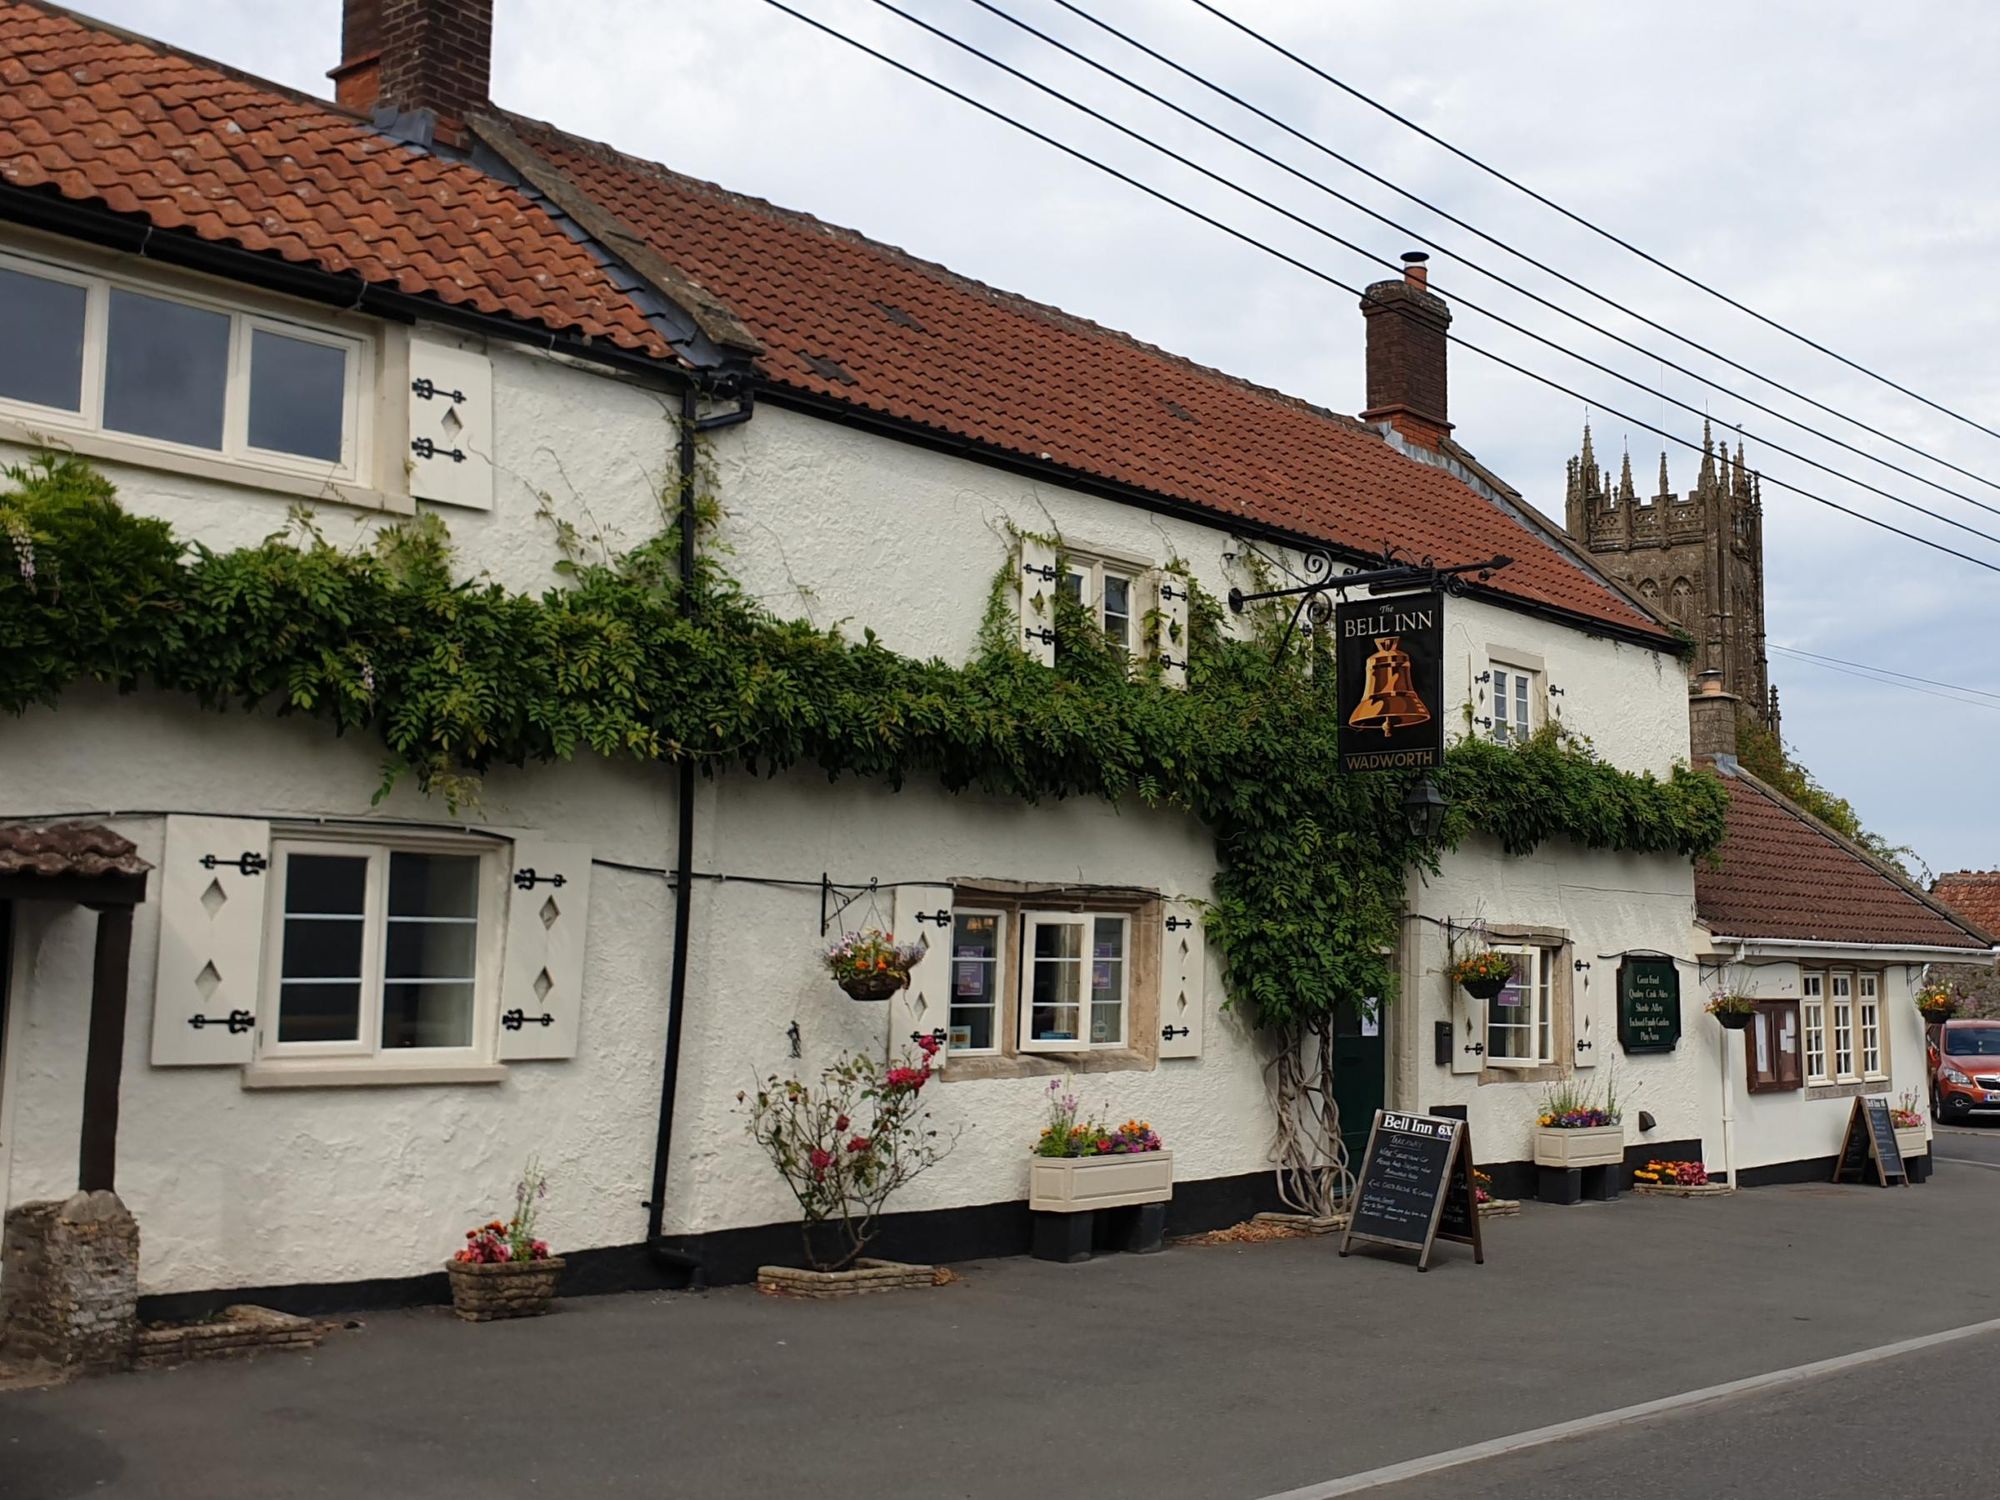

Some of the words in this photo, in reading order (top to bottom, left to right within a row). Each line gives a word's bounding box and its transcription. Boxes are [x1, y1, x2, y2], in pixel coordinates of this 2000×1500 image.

[1379, 604, 1394, 614] The
[1344, 616, 1390, 638] BELL
[1395, 610, 1433, 632] INN
[1346, 751, 1433, 770] WADWORTH
[1383, 1114, 1409, 1131] Bell
[1411, 1119, 1433, 1135] Inn
[1438, 1124, 1453, 1136] 6X
